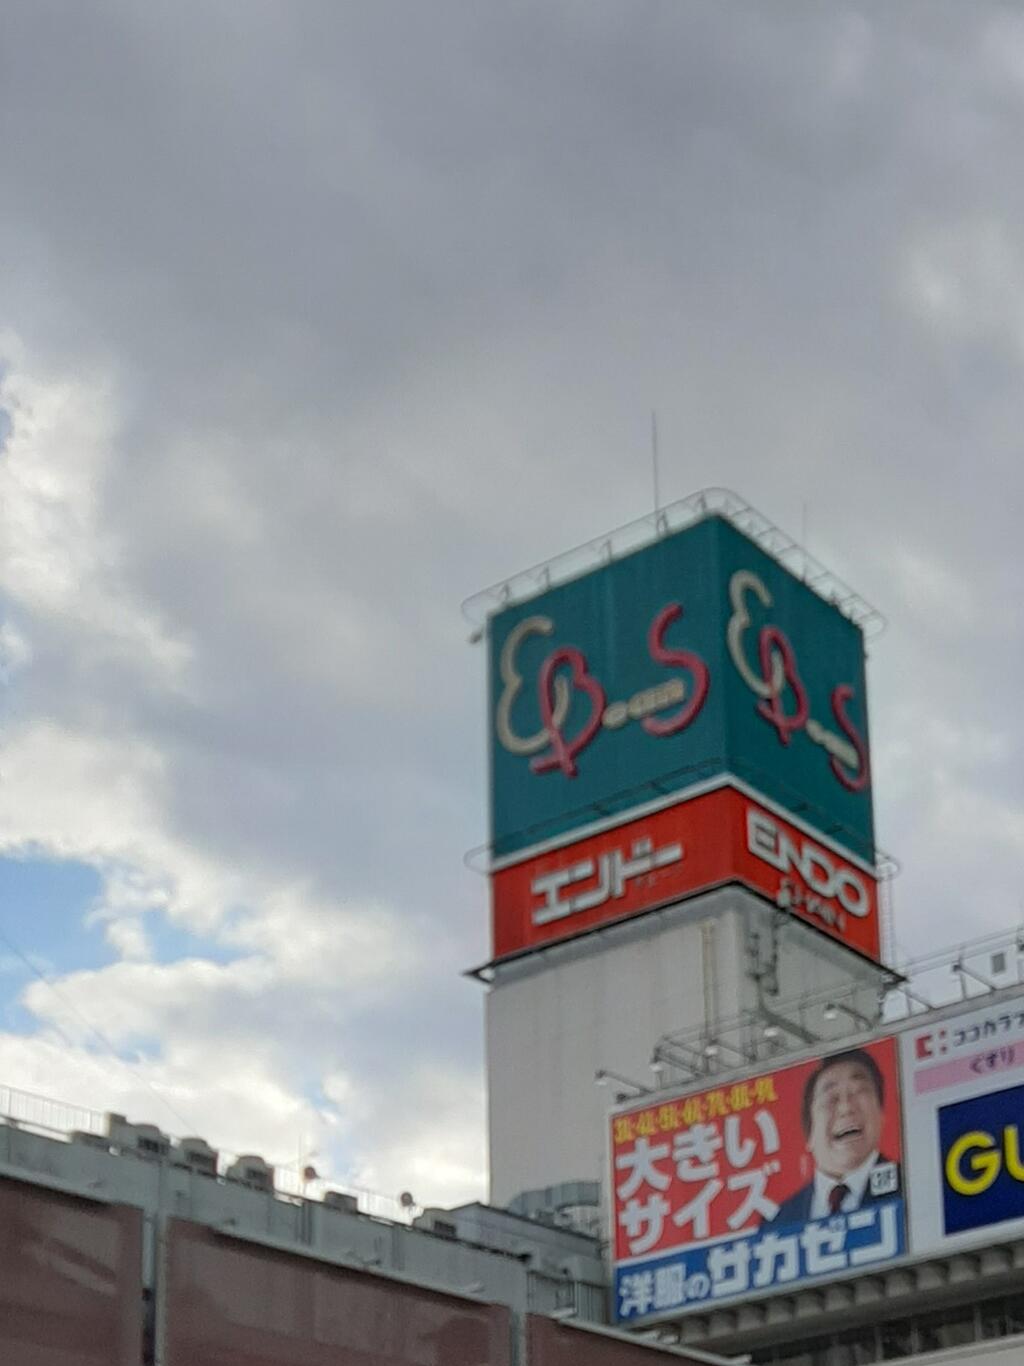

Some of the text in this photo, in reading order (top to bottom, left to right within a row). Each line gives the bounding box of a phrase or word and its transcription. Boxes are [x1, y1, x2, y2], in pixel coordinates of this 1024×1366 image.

[531, 836, 683, 927] エンドー
[746, 808, 870, 918] ENDO
[615, 1108, 781, 1200] 大きい
[618, 1160, 782, 1257] サイズ
